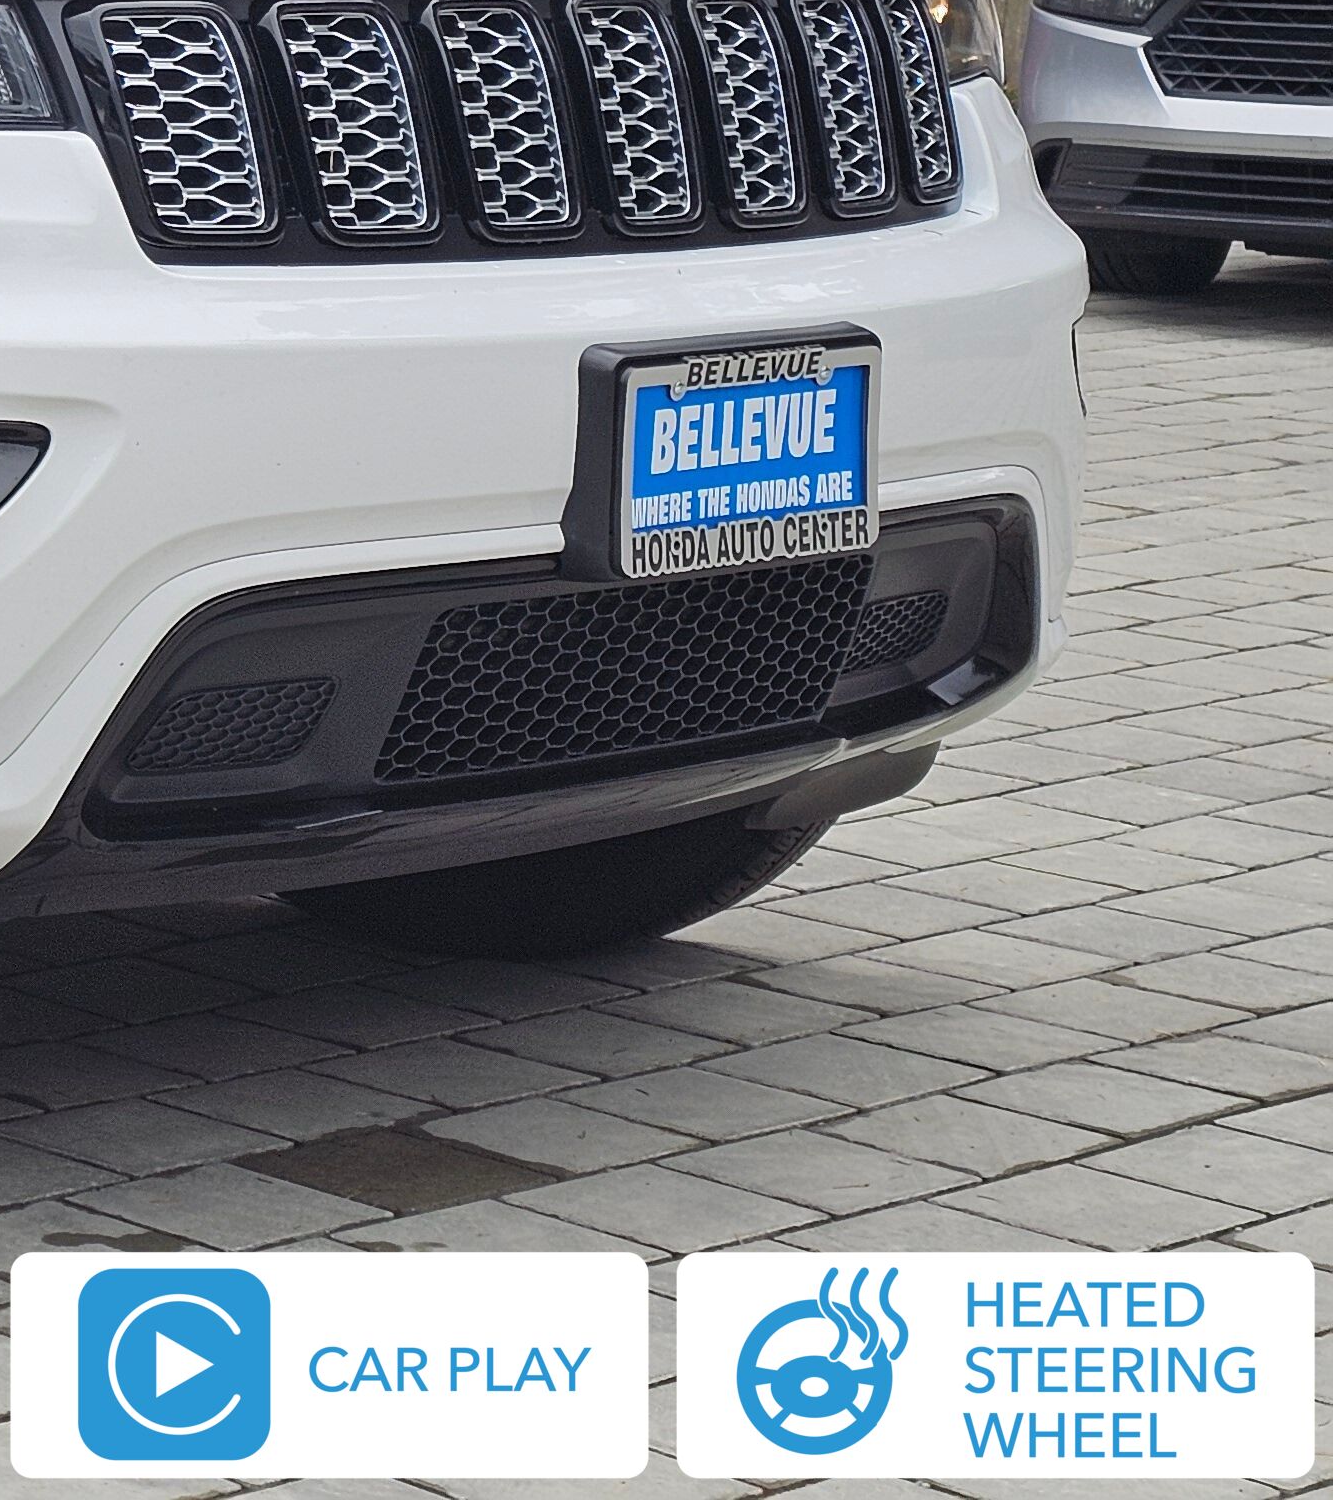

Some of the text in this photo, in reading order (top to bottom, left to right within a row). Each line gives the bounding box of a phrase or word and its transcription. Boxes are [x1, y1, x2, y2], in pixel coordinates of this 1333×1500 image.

[686, 350, 823, 387] BELLEVUE
[650, 389, 837, 475] BELLEVUE
[631, 470, 853, 529] WHERE THE HONDAS ARE
[631, 508, 870, 576] HONDA AUTO CENTER
